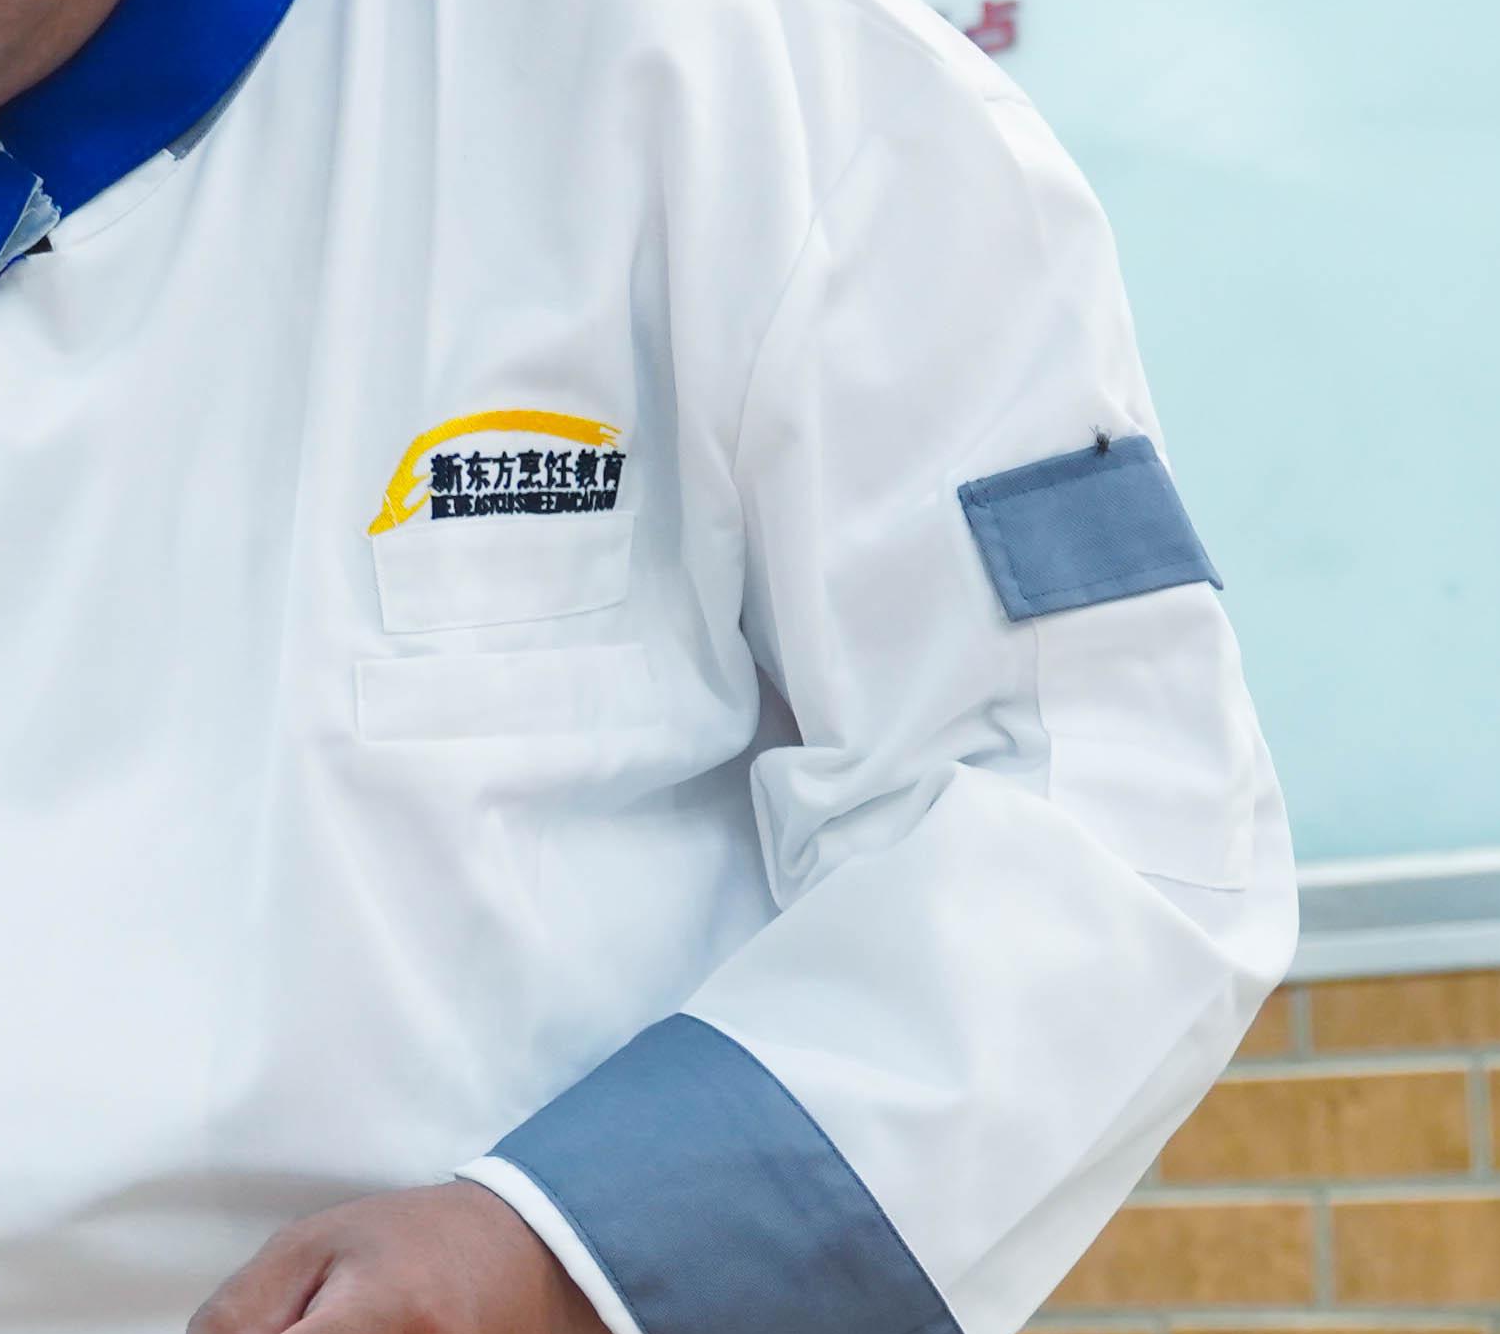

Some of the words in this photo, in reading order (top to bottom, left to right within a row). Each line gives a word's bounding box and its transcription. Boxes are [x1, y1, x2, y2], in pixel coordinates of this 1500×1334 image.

[428, 449, 627, 493] 新东方烹饪教育
